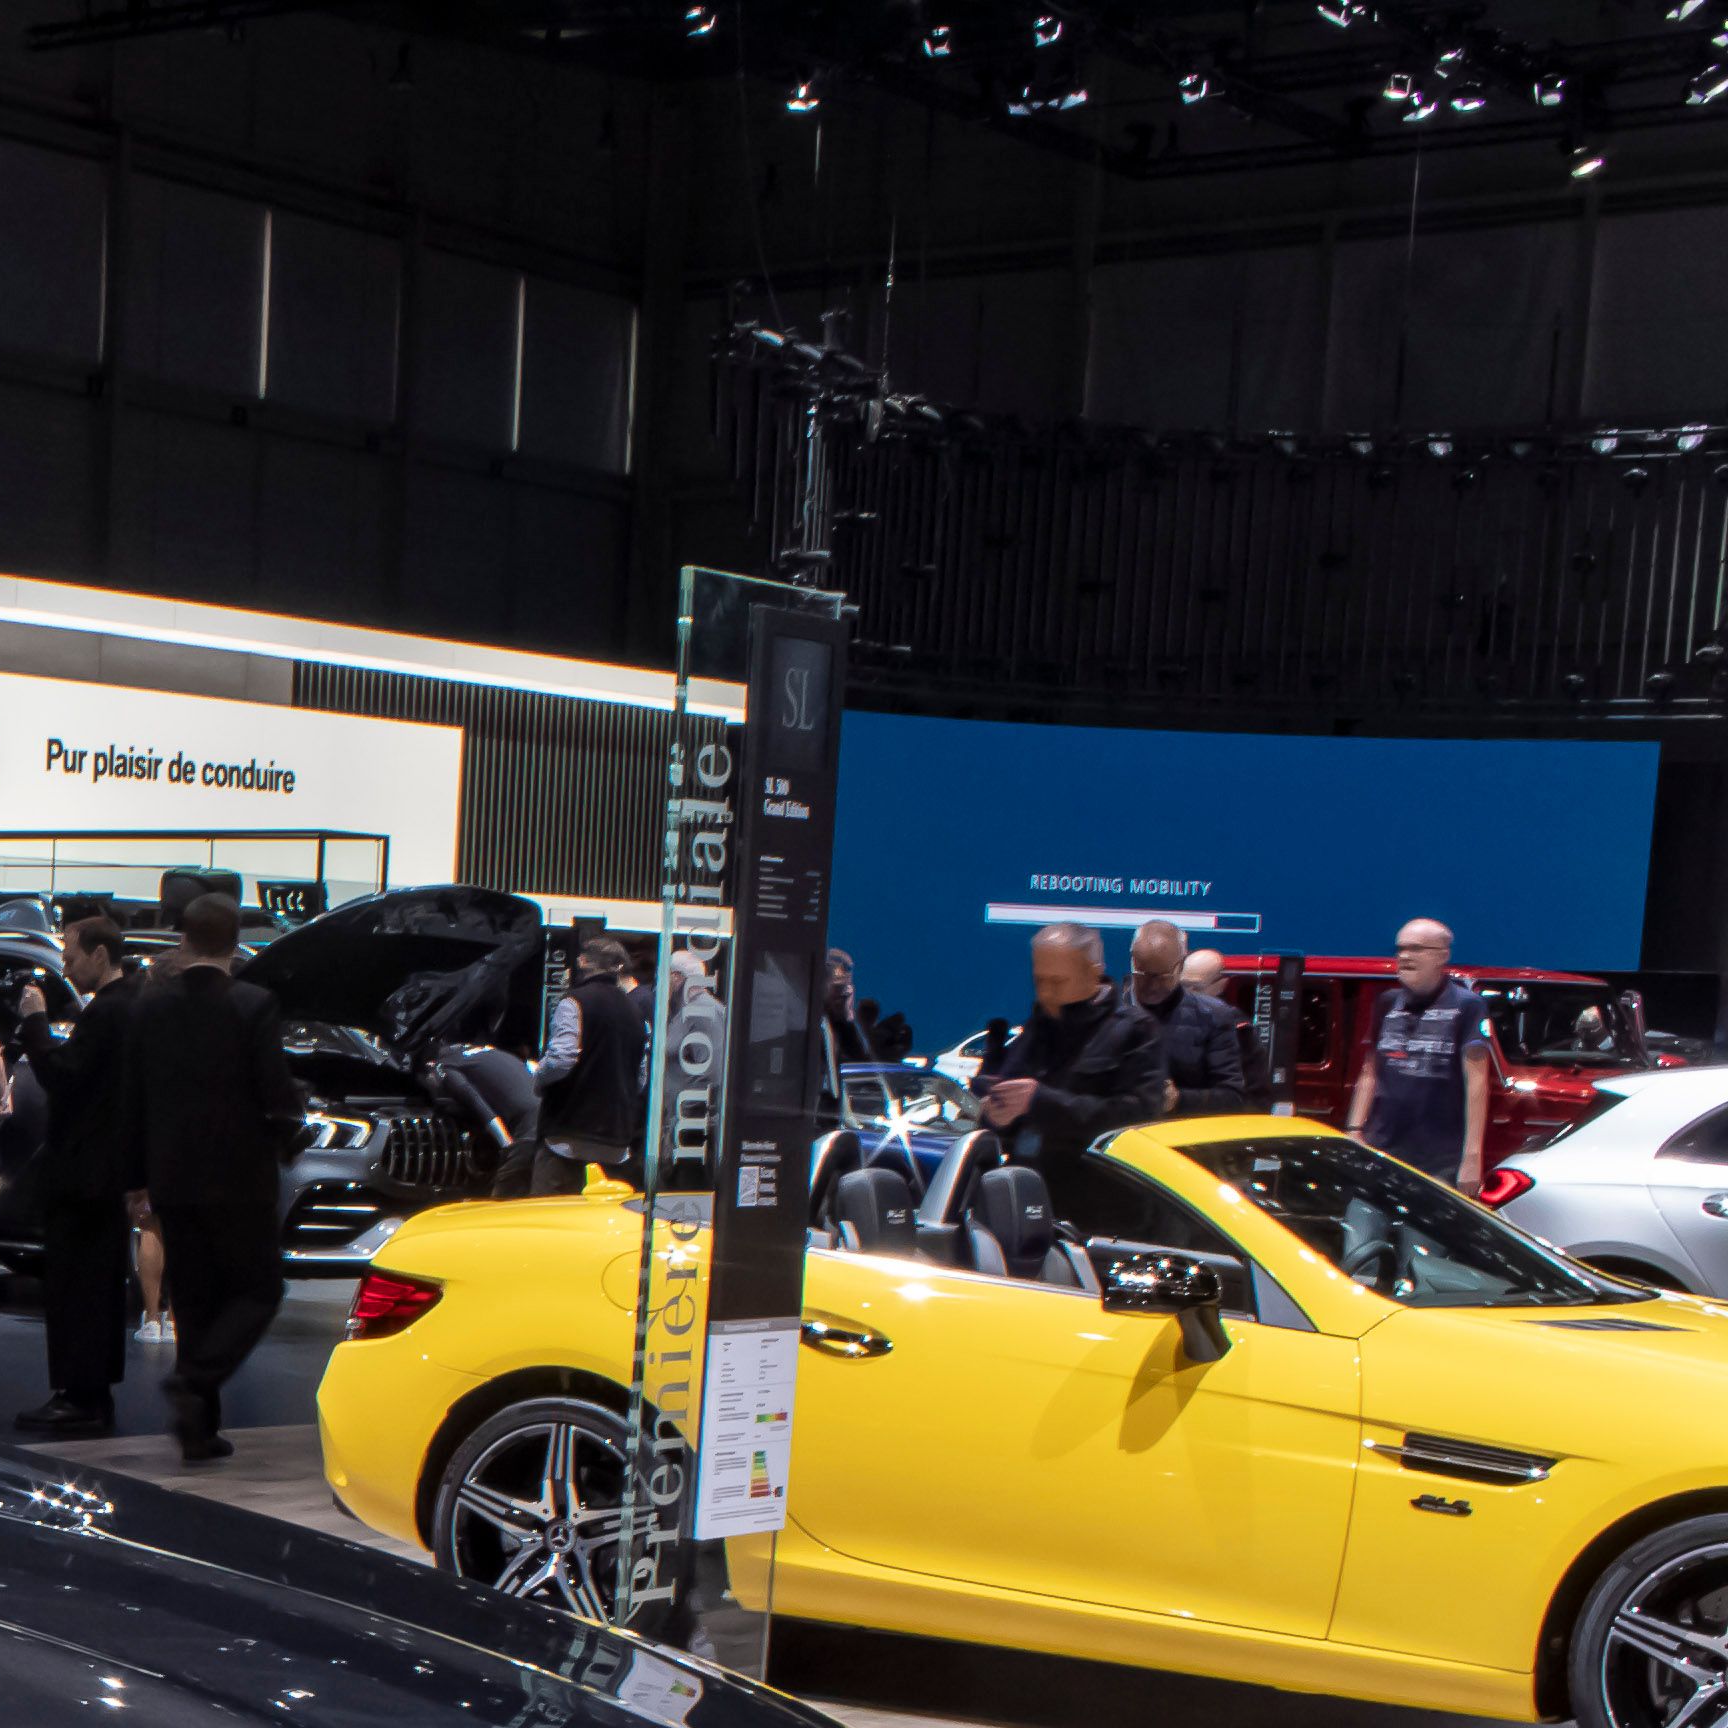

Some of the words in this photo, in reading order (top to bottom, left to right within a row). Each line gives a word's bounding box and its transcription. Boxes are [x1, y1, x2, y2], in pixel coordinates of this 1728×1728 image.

[782, 667, 814, 730] SL
[46, 738, 88, 774] Pur
[93, 744, 163, 783] plaisir
[167, 750, 196, 786] de
[201, 757, 297, 796] conduire
[1029, 874, 1124, 894] REBOOTING
[1129, 878, 1213, 897] MOBILITY
[629, 1198, 702, 1606] Première
[672, 742, 733, 1167] mondiale
